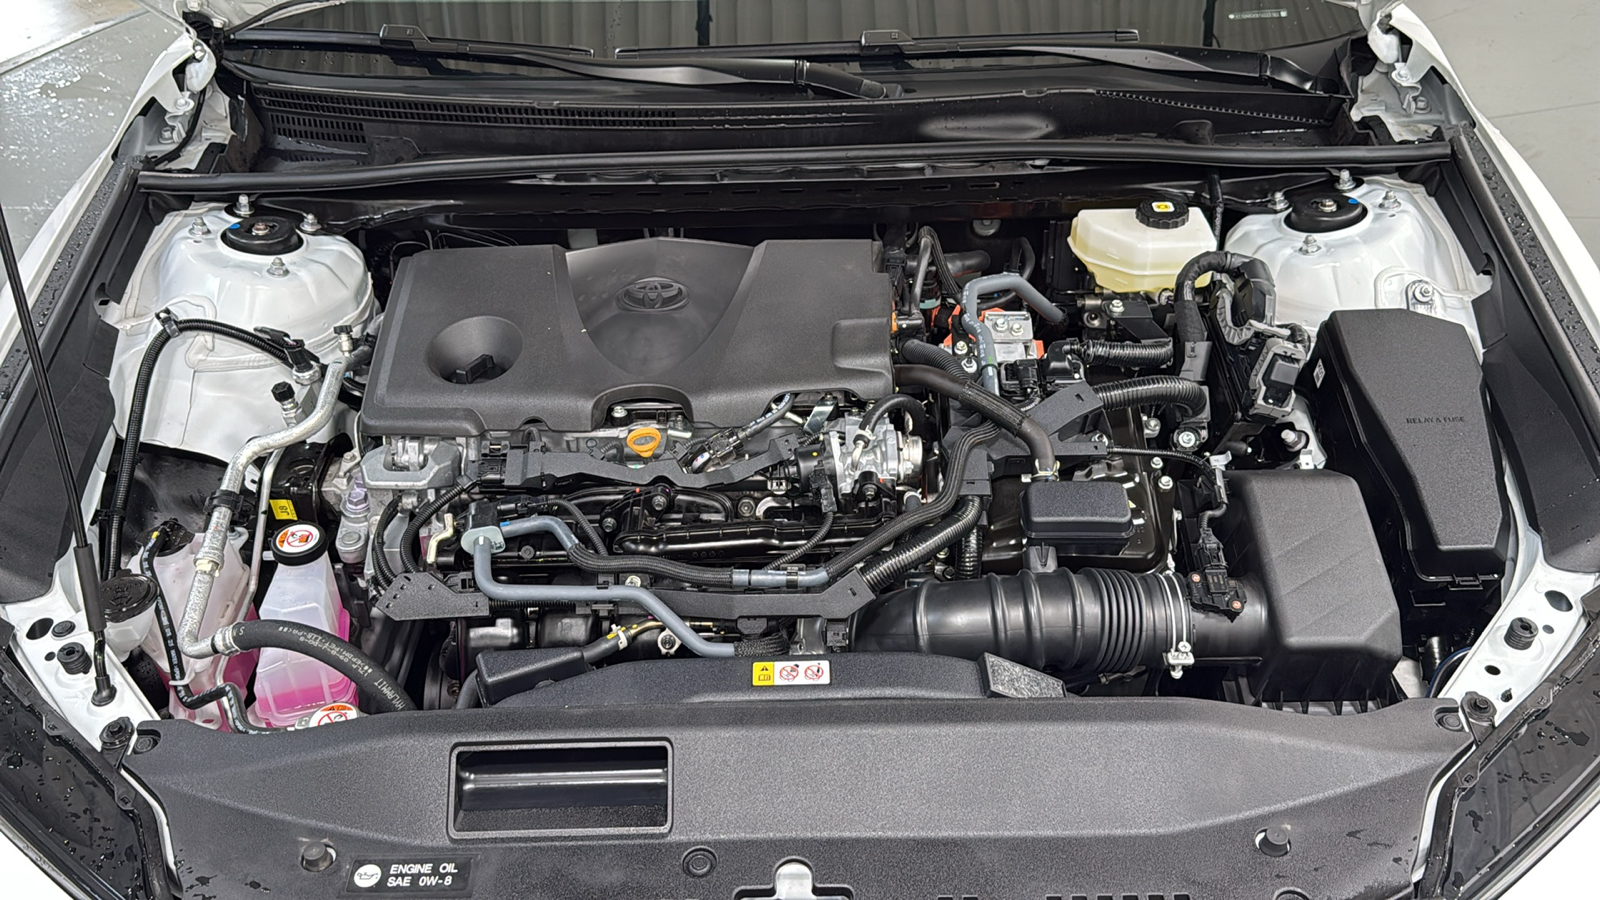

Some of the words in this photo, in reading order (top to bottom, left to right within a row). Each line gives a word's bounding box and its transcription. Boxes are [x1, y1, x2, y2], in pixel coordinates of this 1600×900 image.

[390, 863, 433, 874] ENGINE
[439, 862, 458, 873] OIL
[387, 876, 412, 887] SAE
[418, 876, 452, 886] 0W-8
